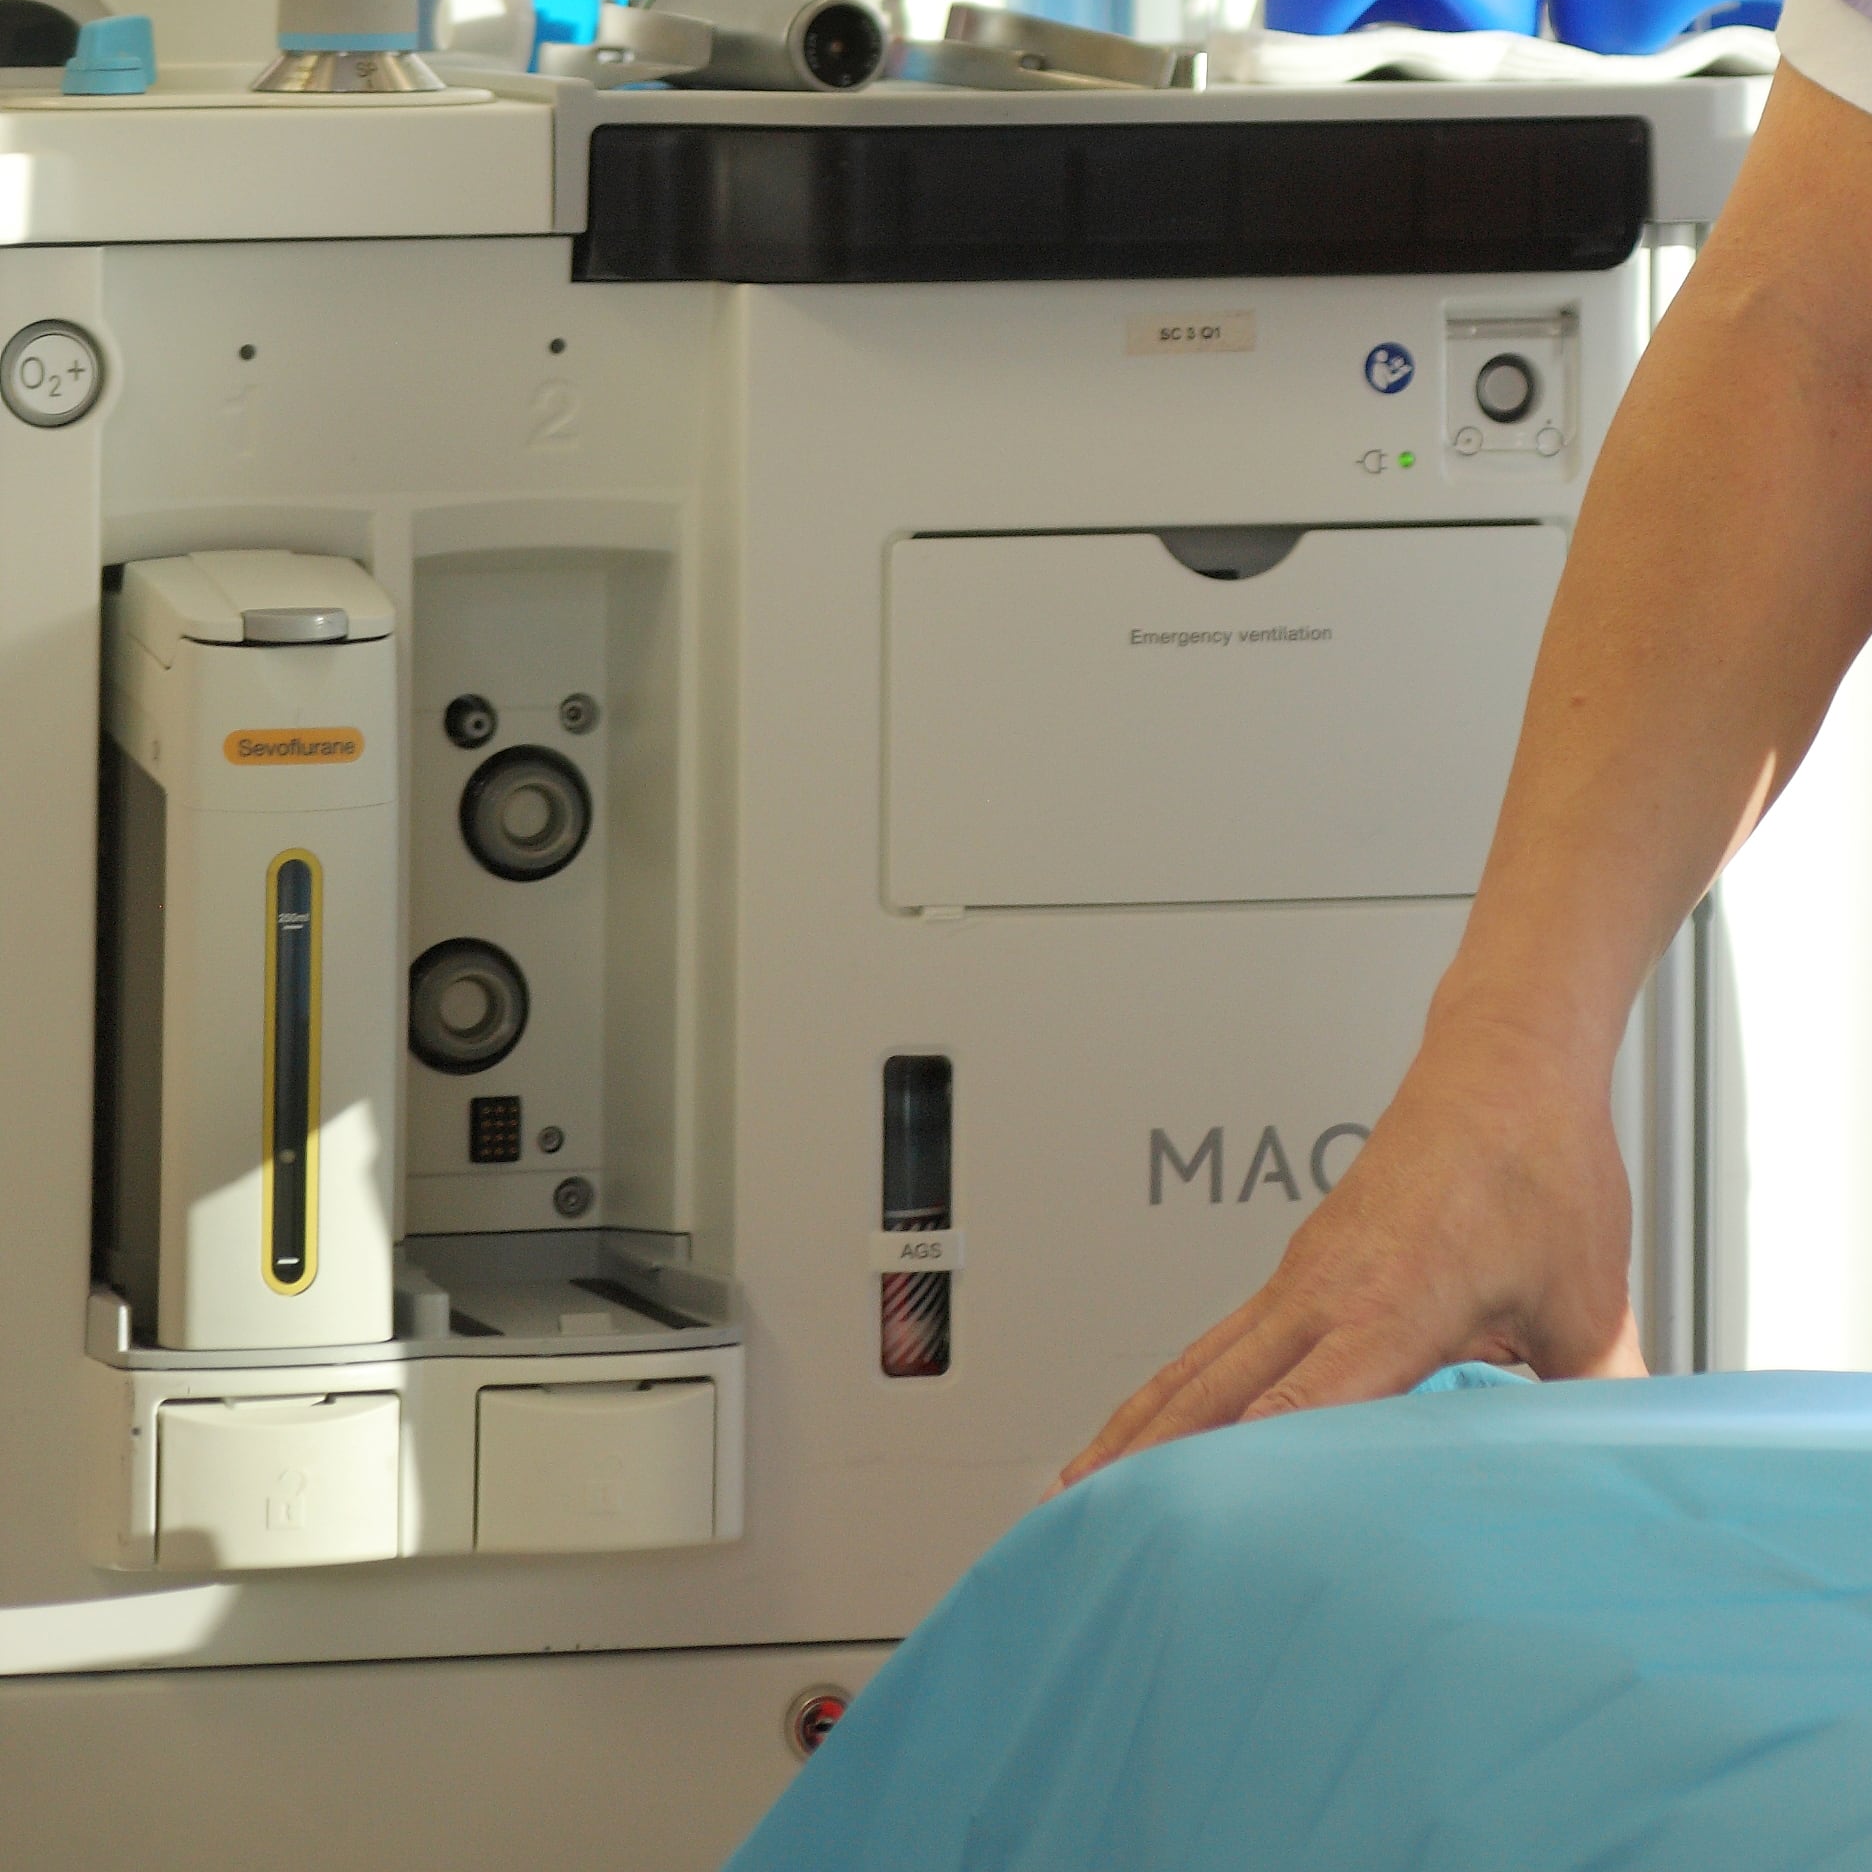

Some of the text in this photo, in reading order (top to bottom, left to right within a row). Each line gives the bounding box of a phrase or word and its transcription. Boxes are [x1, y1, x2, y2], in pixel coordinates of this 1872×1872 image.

[1130, 625, 1333, 647] Emergency ventilation
[238, 738, 356, 758] Sevoflurane
[900, 1242, 943, 1260] AGS
